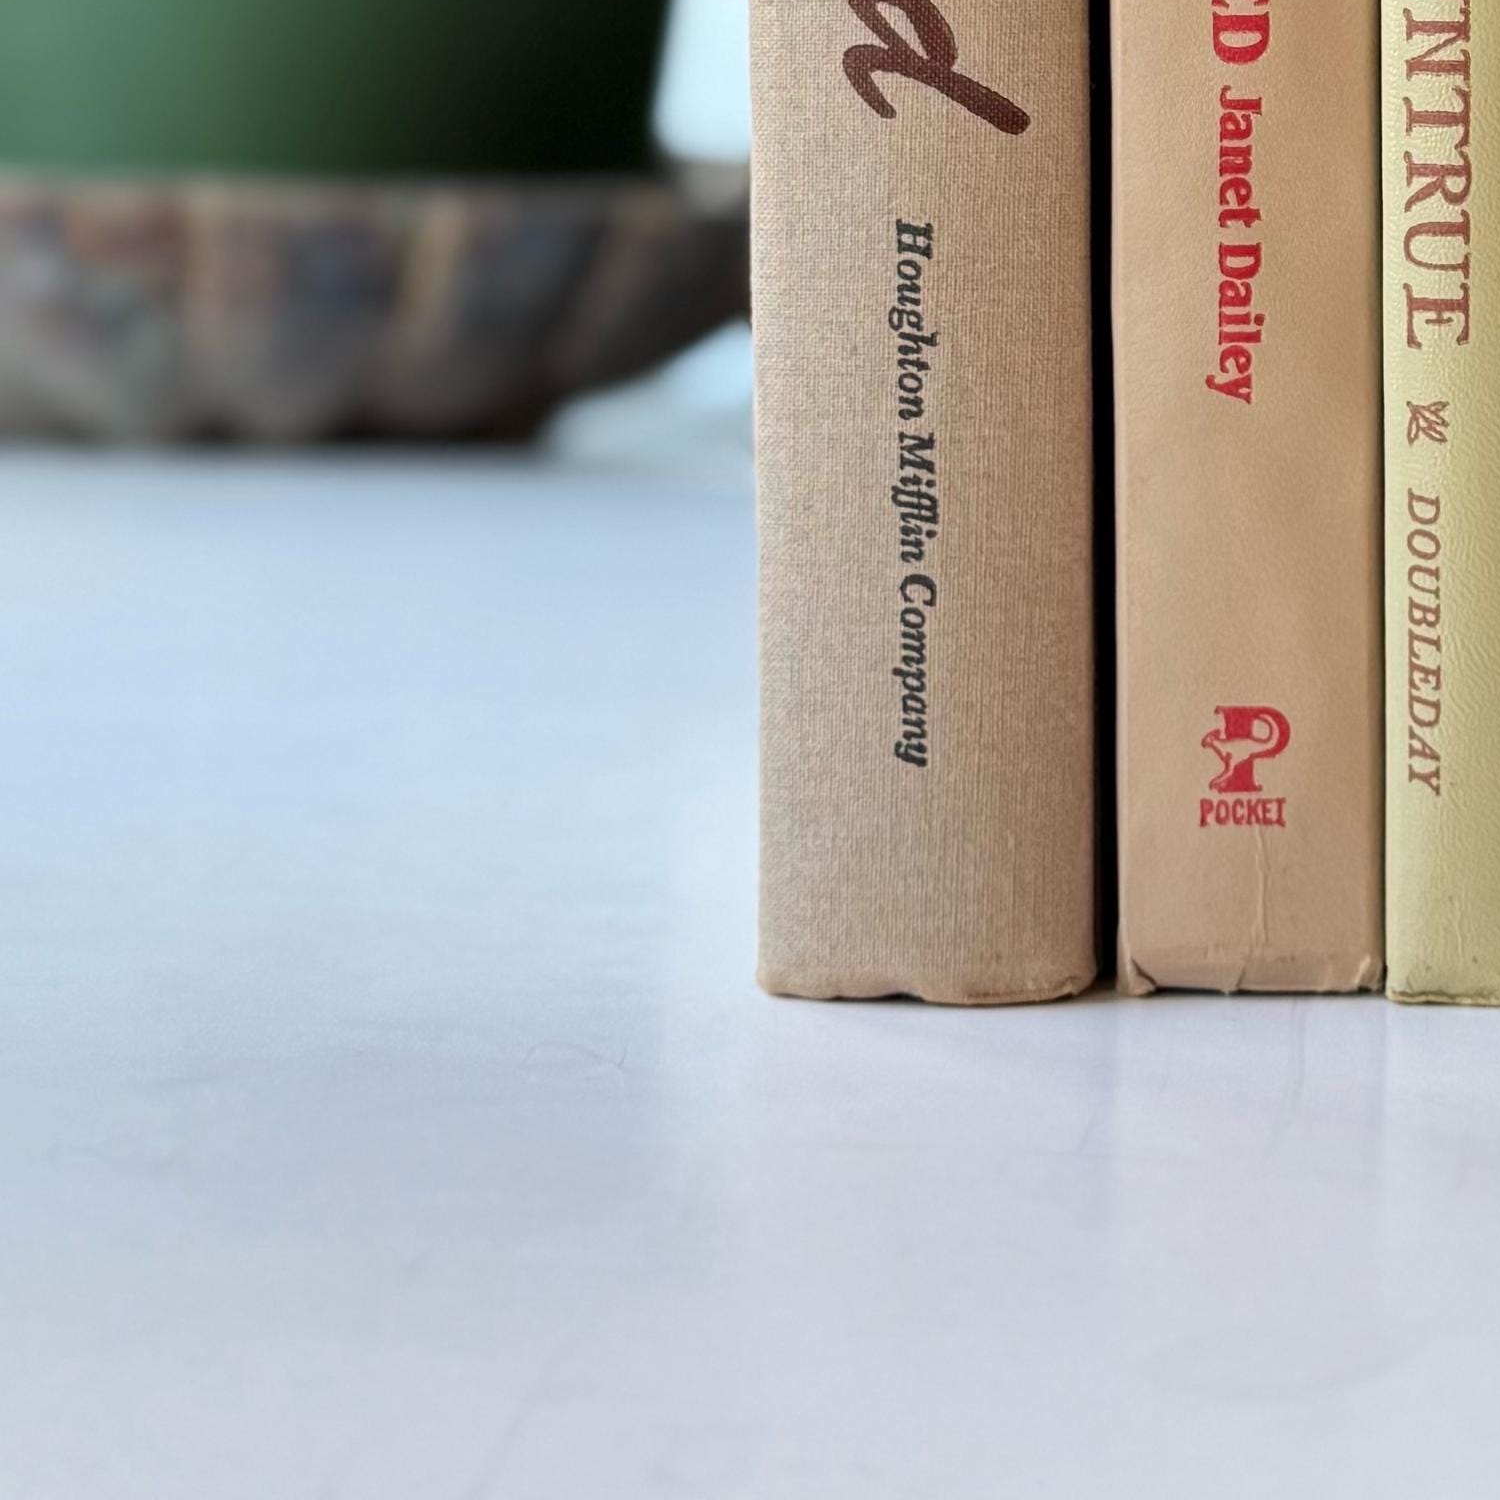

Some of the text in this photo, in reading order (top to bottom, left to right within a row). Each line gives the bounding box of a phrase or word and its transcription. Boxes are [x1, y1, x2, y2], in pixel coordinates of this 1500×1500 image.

[1206, 88, 1263, 402] Janet Dailey
[888, 219, 939, 767] Houghton Mifflin Company
[1405, 487, 1443, 796] DOUBLEDAY
[1198, 797, 1287, 828] POCKET
